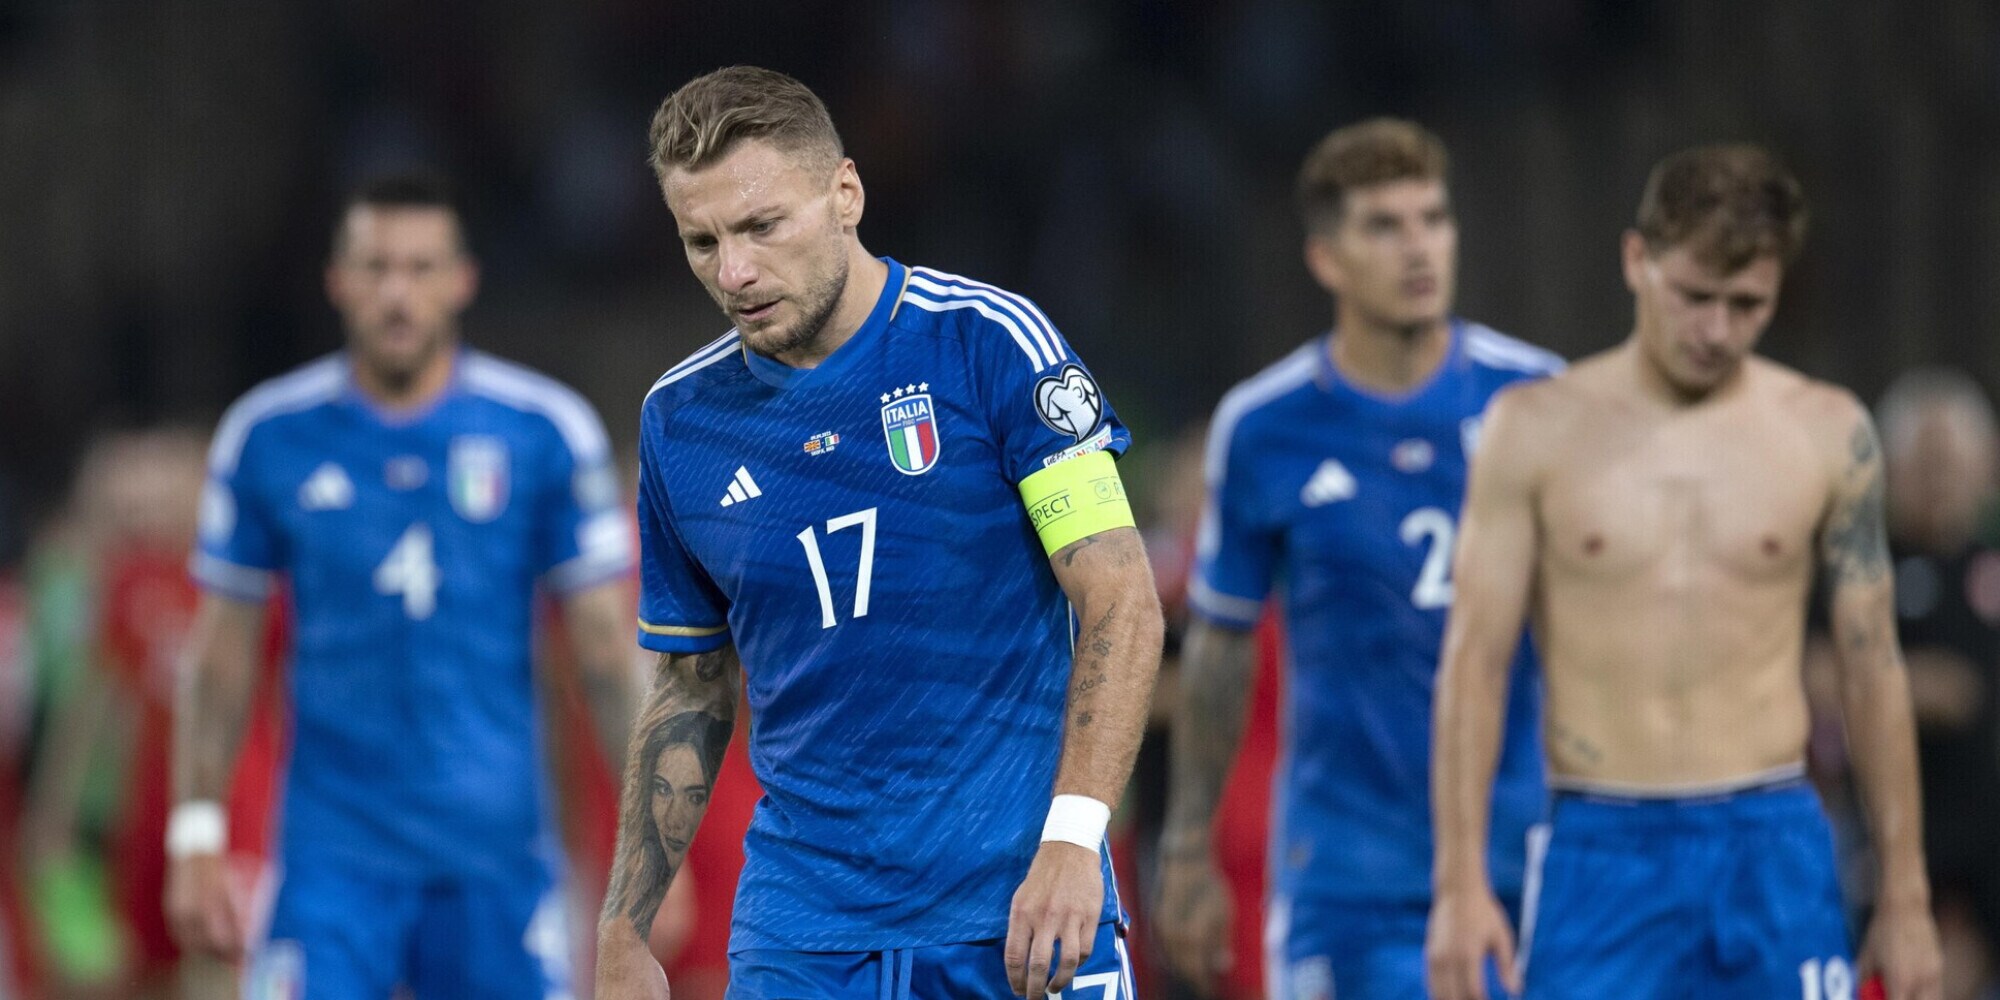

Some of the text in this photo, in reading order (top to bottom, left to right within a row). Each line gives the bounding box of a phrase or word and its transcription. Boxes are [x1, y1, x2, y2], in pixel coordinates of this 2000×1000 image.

[885, 400, 929, 425] ITALIA
[1030, 494, 1070, 527] SPECT
[1398, 505, 1457, 610] 2
[371, 521, 443, 621] 4
[796, 506, 877, 629] 17
